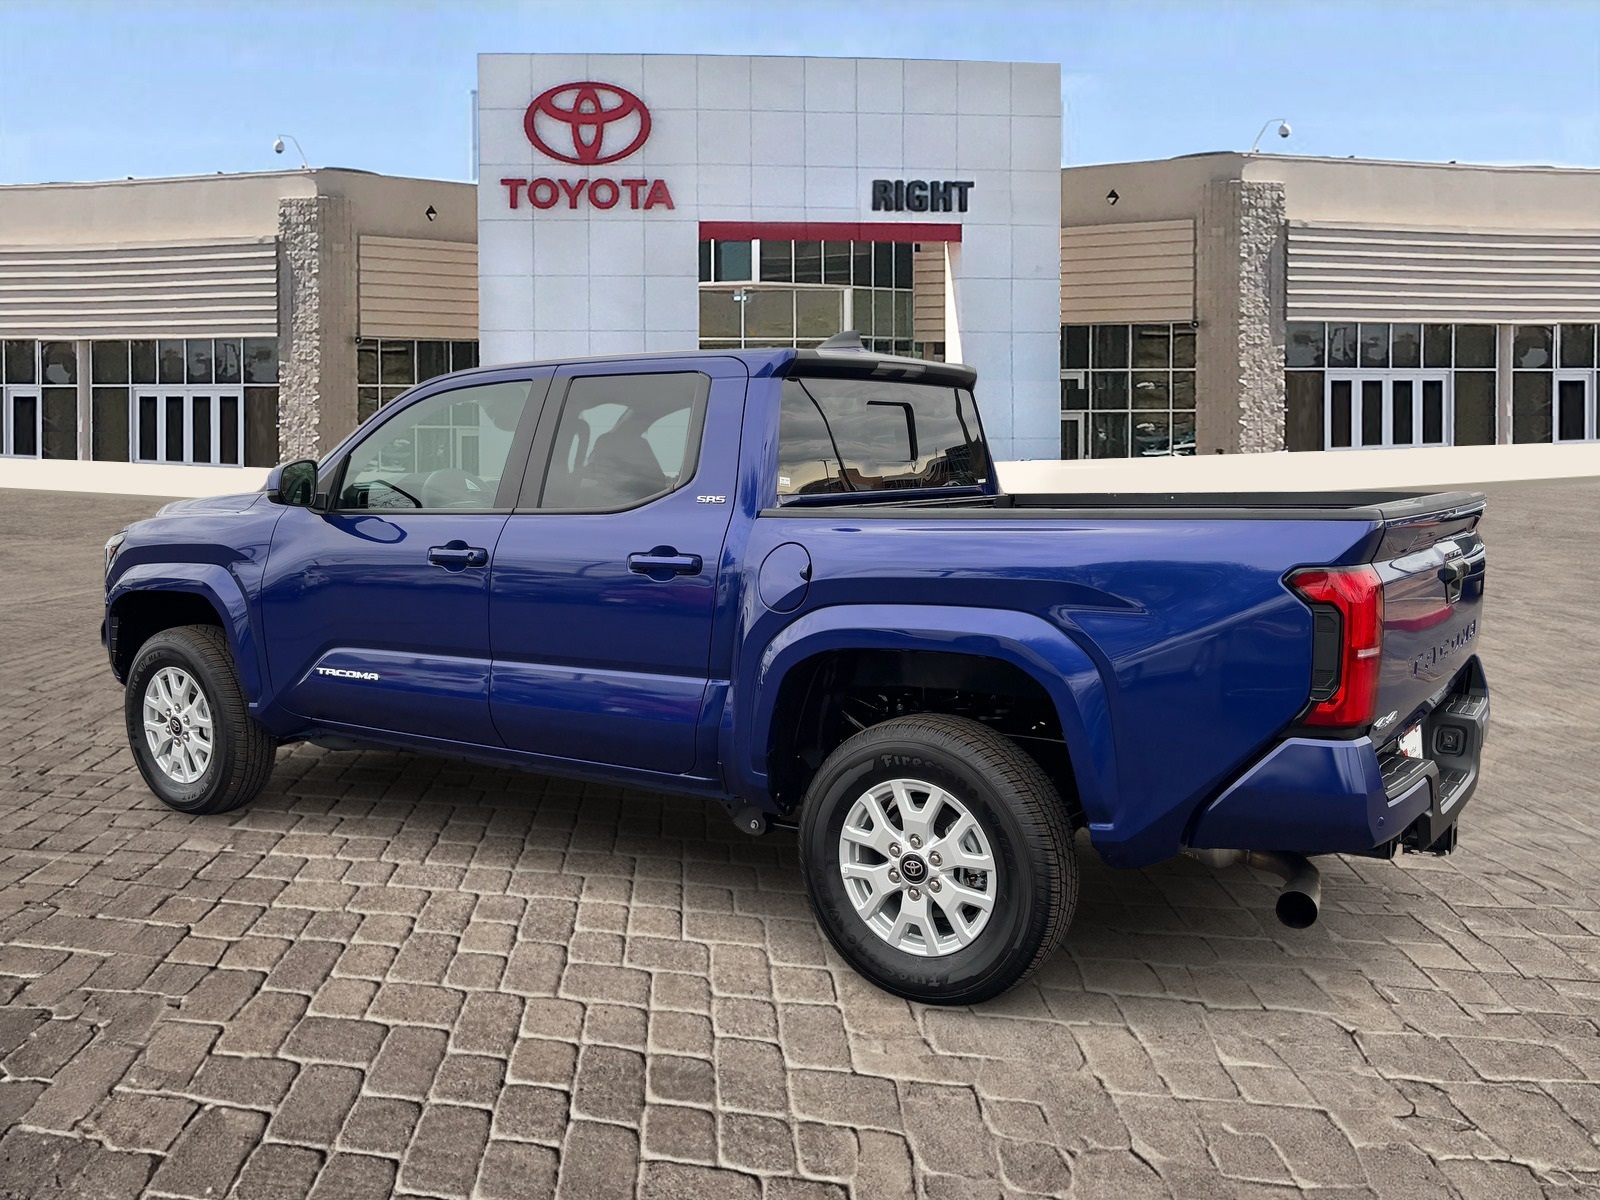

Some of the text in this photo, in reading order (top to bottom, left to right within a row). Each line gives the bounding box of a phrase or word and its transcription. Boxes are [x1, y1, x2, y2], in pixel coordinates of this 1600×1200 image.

[500, 178, 675, 210] TOYOTA
[872, 179, 975, 213] RIGHT
[696, 495, 727, 504] SR5
[316, 667, 379, 681] TACOMA
